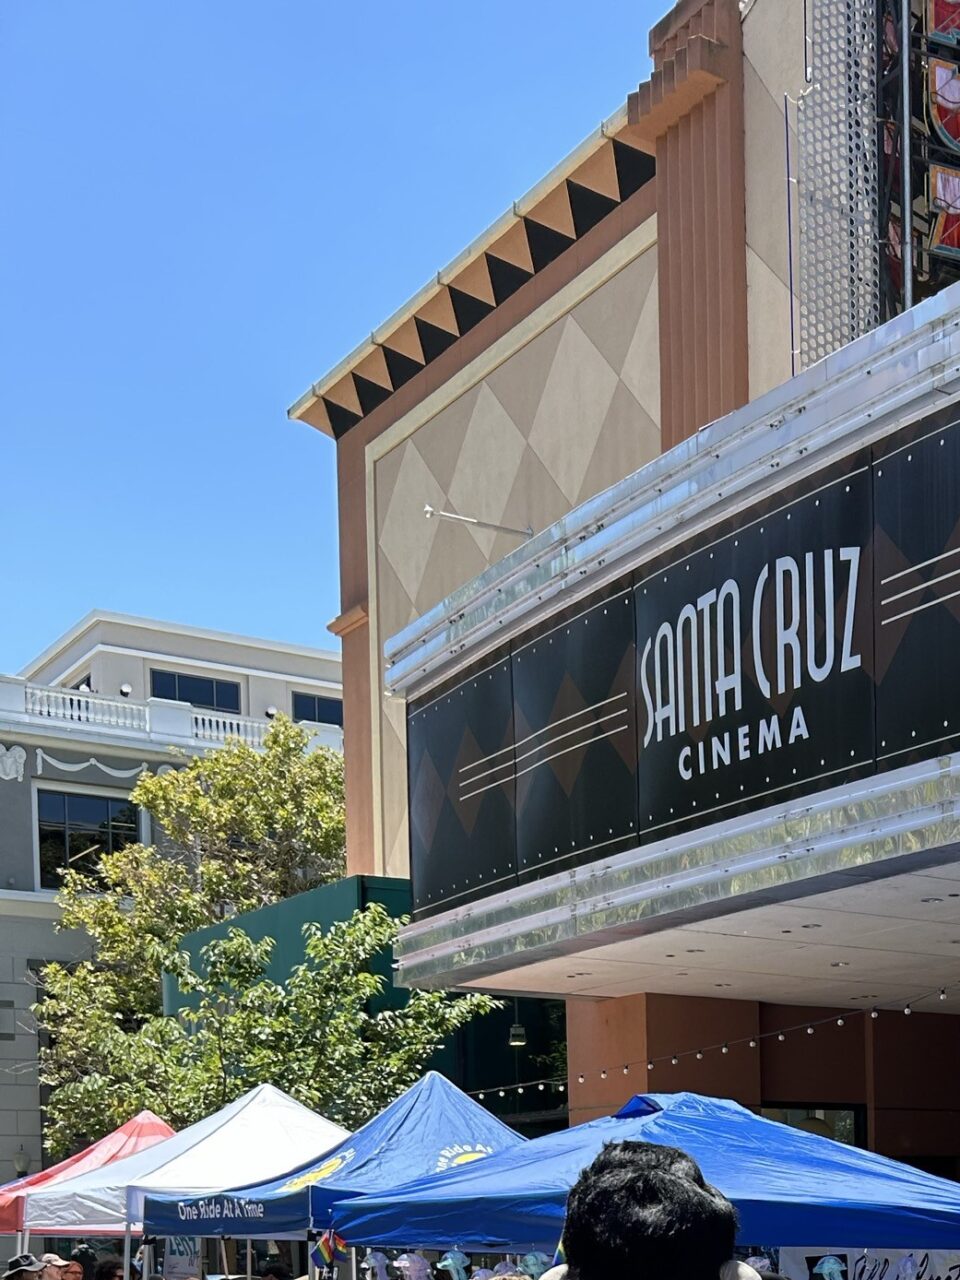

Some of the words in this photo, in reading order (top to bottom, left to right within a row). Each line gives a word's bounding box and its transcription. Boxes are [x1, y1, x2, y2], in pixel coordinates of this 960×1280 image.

[640, 578, 742, 748] SANTA
[752, 546, 861, 699] CRUZ
[678, 706, 810, 781] CINEMA
[178, 1202, 198, 1220] One
[198, 1199, 220, 1219] Ride
[222, 1199, 234, 1218] At
[240, 1198, 264, 1218] Time
